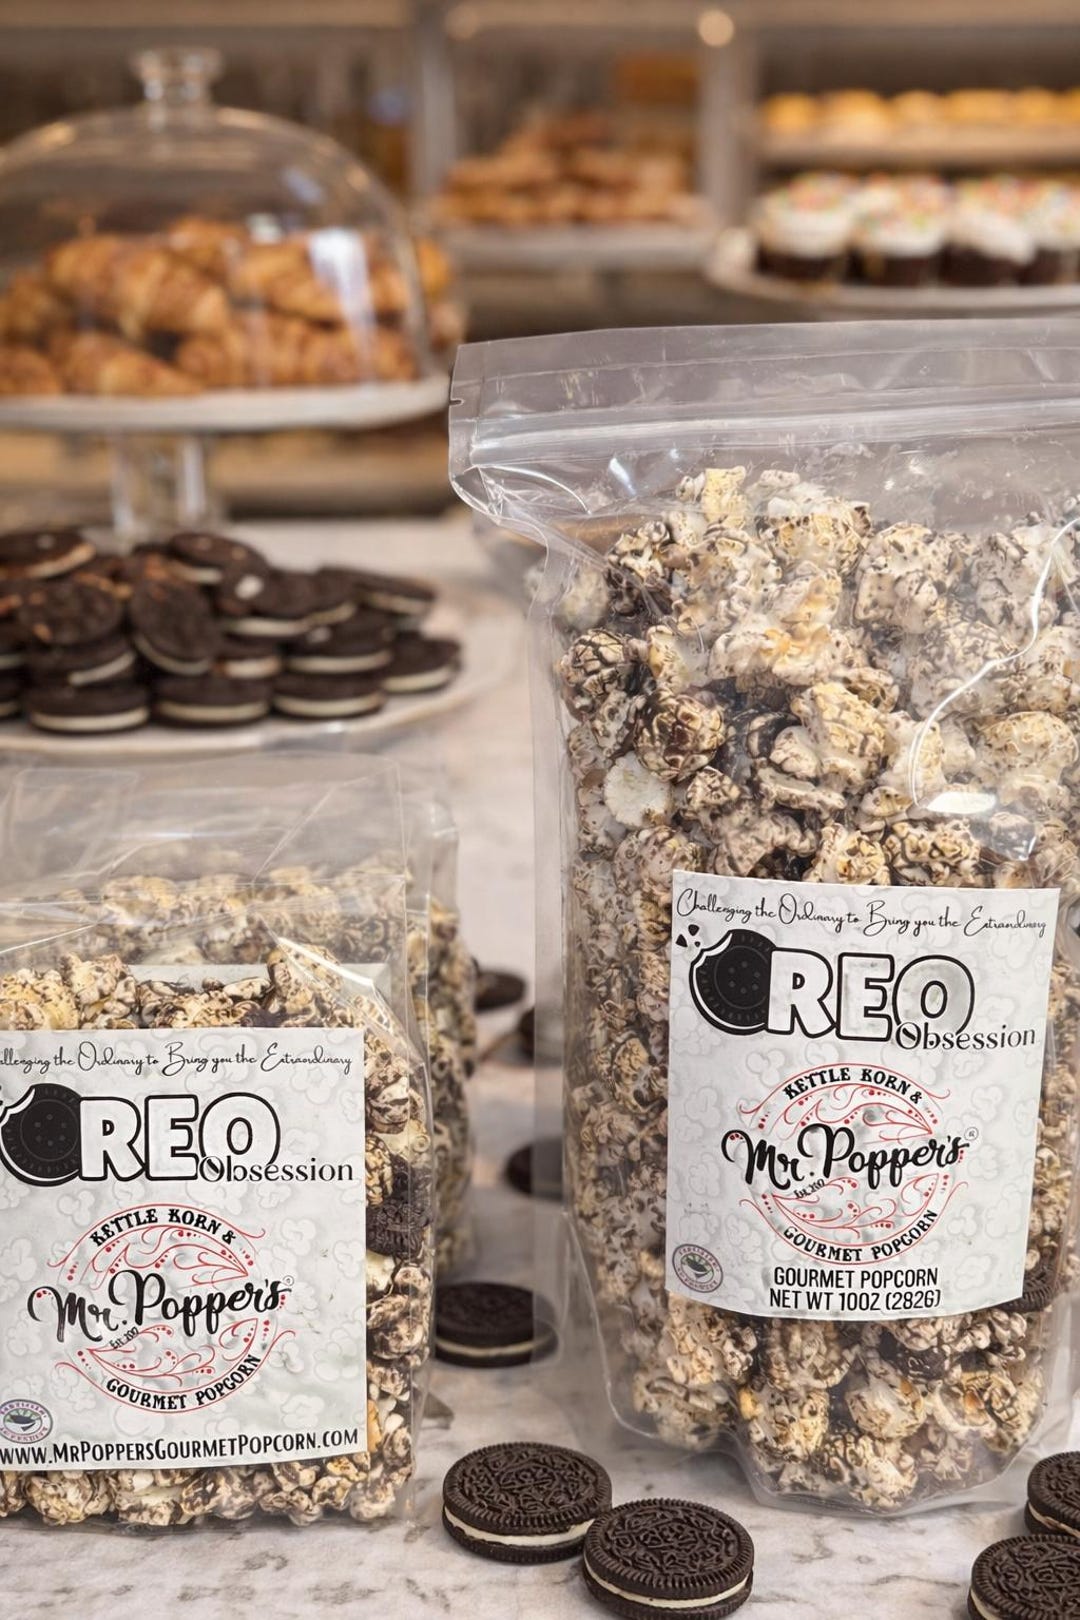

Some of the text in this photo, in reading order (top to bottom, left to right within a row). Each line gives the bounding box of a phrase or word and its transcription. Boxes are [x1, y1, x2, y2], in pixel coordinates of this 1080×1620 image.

[677, 888, 752, 923] Challenging
[755, 897, 776, 918] the
[846, 912, 861, 923] to
[863, 900, 910, 936] Bring
[914, 919, 936, 937] you
[939, 906, 961, 928] the
[895, 1021, 1035, 1050] Obsession
[53, 1046, 75, 1065] the
[145, 1055, 159, 1065] to
[162, 1042, 208, 1076] Bring
[211, 1057, 233, 1073] you
[235, 1044, 257, 1063] the
[783, 1068, 922, 1104] KETTLE KORN &
[199, 1156, 353, 1183] Obsession
[721, 1123, 970, 1190] Mr. Popper's
[90, 1209, 236, 1246] KETTLE KORN &
[784, 1210, 938, 1261] GOURMET POPCORN
[774, 1267, 938, 1288] GOURMET POPCORN
[27, 1269, 292, 1342] Mr. Popper's
[770, 1288, 801, 1309] NET
[806, 1291, 834, 1310] WT
[885, 1289, 941, 1310] (282G)
[107, 1355, 261, 1410] GOURMET POPCORN
